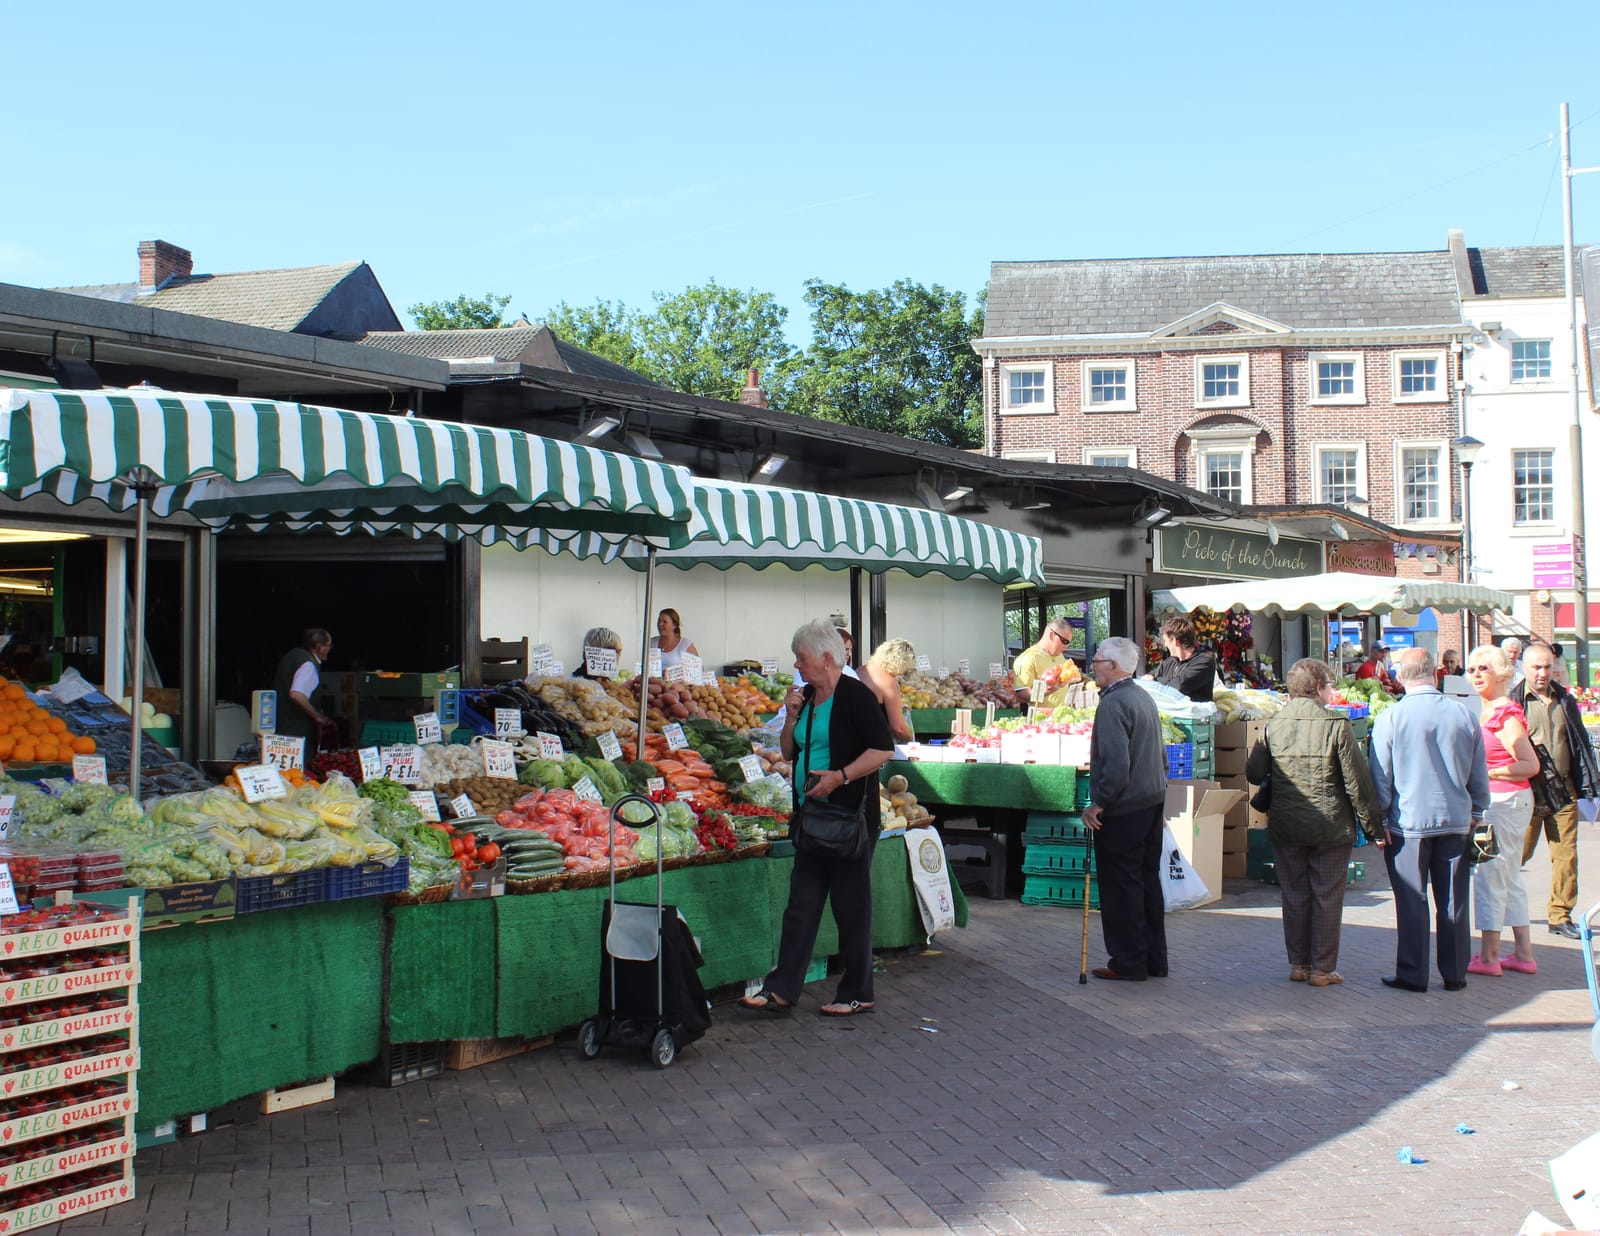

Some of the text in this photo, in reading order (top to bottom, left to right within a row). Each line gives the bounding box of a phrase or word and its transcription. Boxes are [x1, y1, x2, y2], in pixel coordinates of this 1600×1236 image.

[1182, 529, 1307, 570] Pick of the Bunch
[267, 745, 300, 755] SATSUMAS
[393, 757, 415, 765] PLUMS
[19, 925, 120, 951] REO QUALITY
[20, 969, 121, 997] REO QUALITY
[20, 1013, 121, 1042] REO QUALITY
[20, 1056, 121, 1088] REO QUALITY
[19, 1100, 119, 1135] REO QUALITY
[14, 1144, 117, 1184] REO QUALITY
[14, 1187, 116, 1227] REO QUALITY
